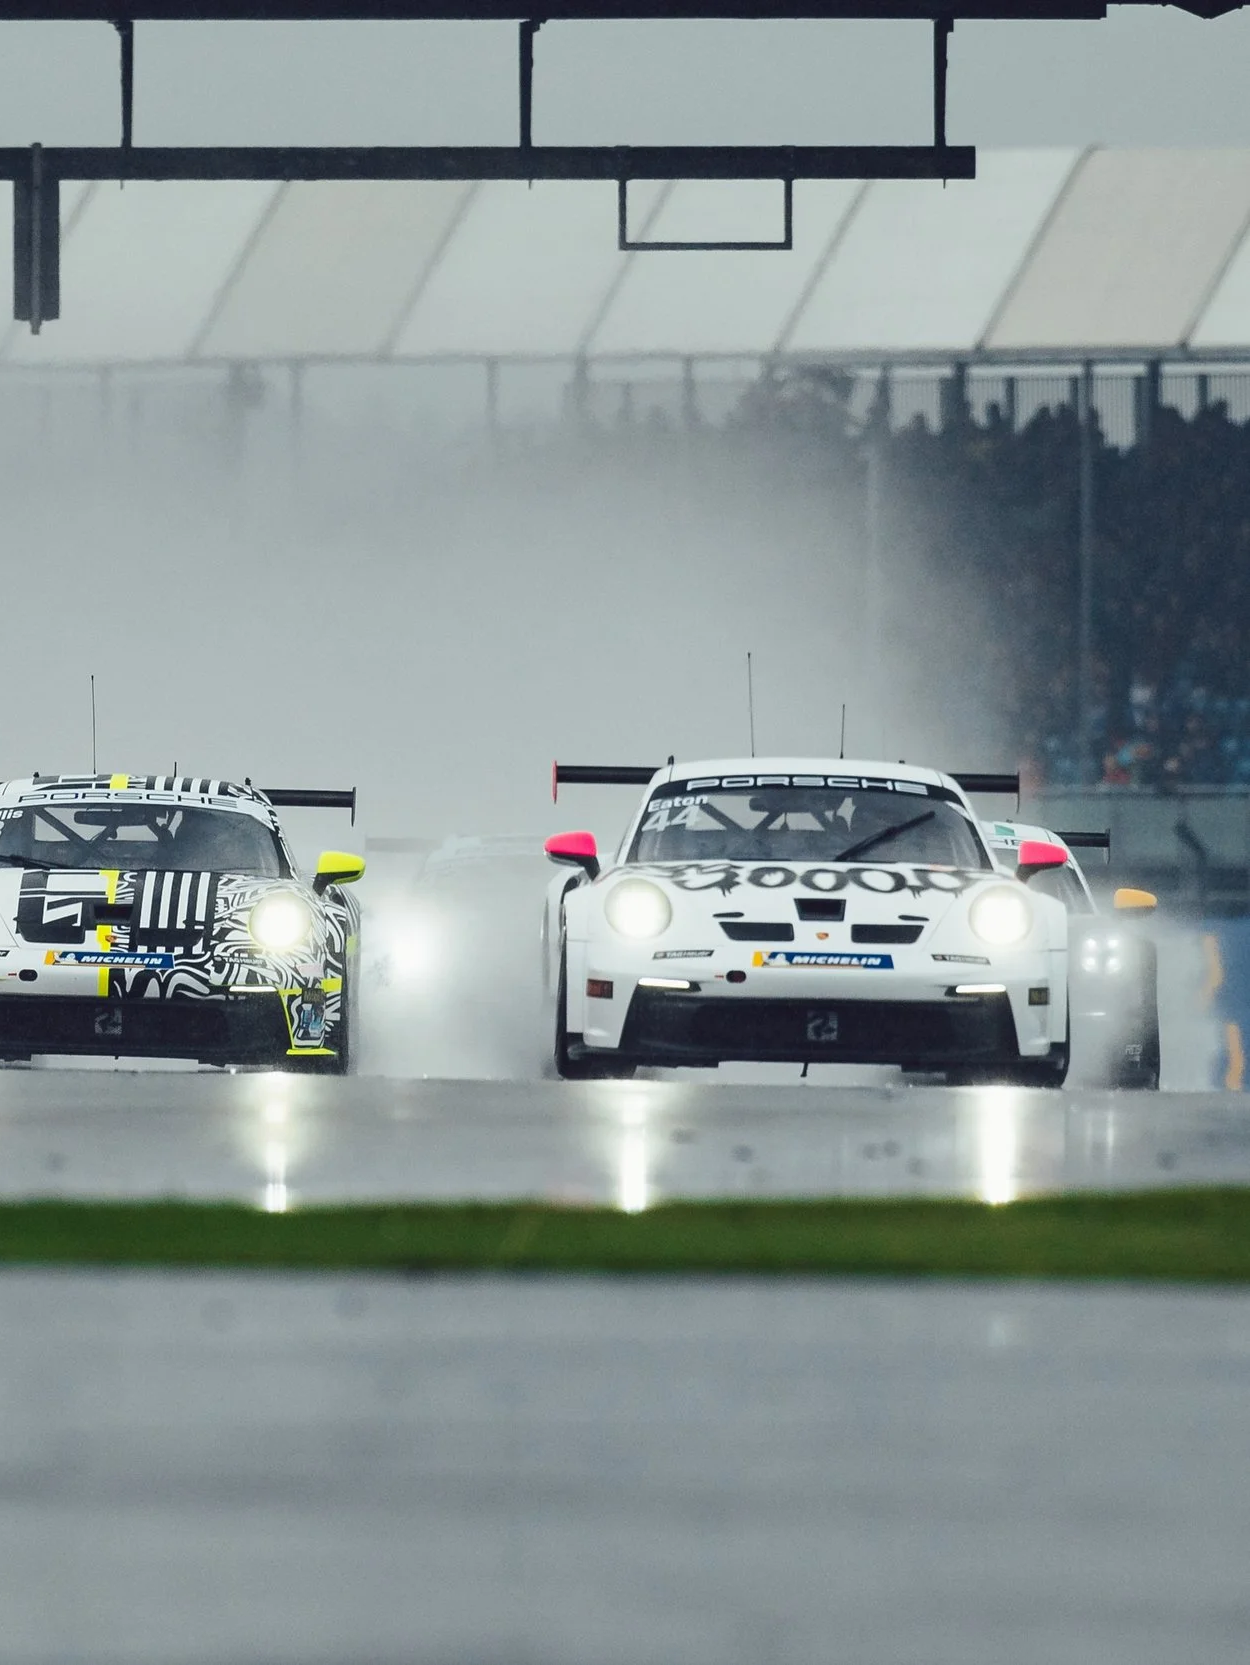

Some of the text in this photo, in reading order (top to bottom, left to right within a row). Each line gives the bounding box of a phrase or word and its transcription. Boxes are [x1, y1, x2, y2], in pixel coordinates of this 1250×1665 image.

[686, 776, 929, 795] PORSCHE
[18, 792, 238, 808] PORSCHE
[648, 794, 708, 813] Eaton
[641, 805, 700, 832] 44
[80, 955, 163, 965] MICHELIN
[792, 955, 882, 965] MICHELIN
